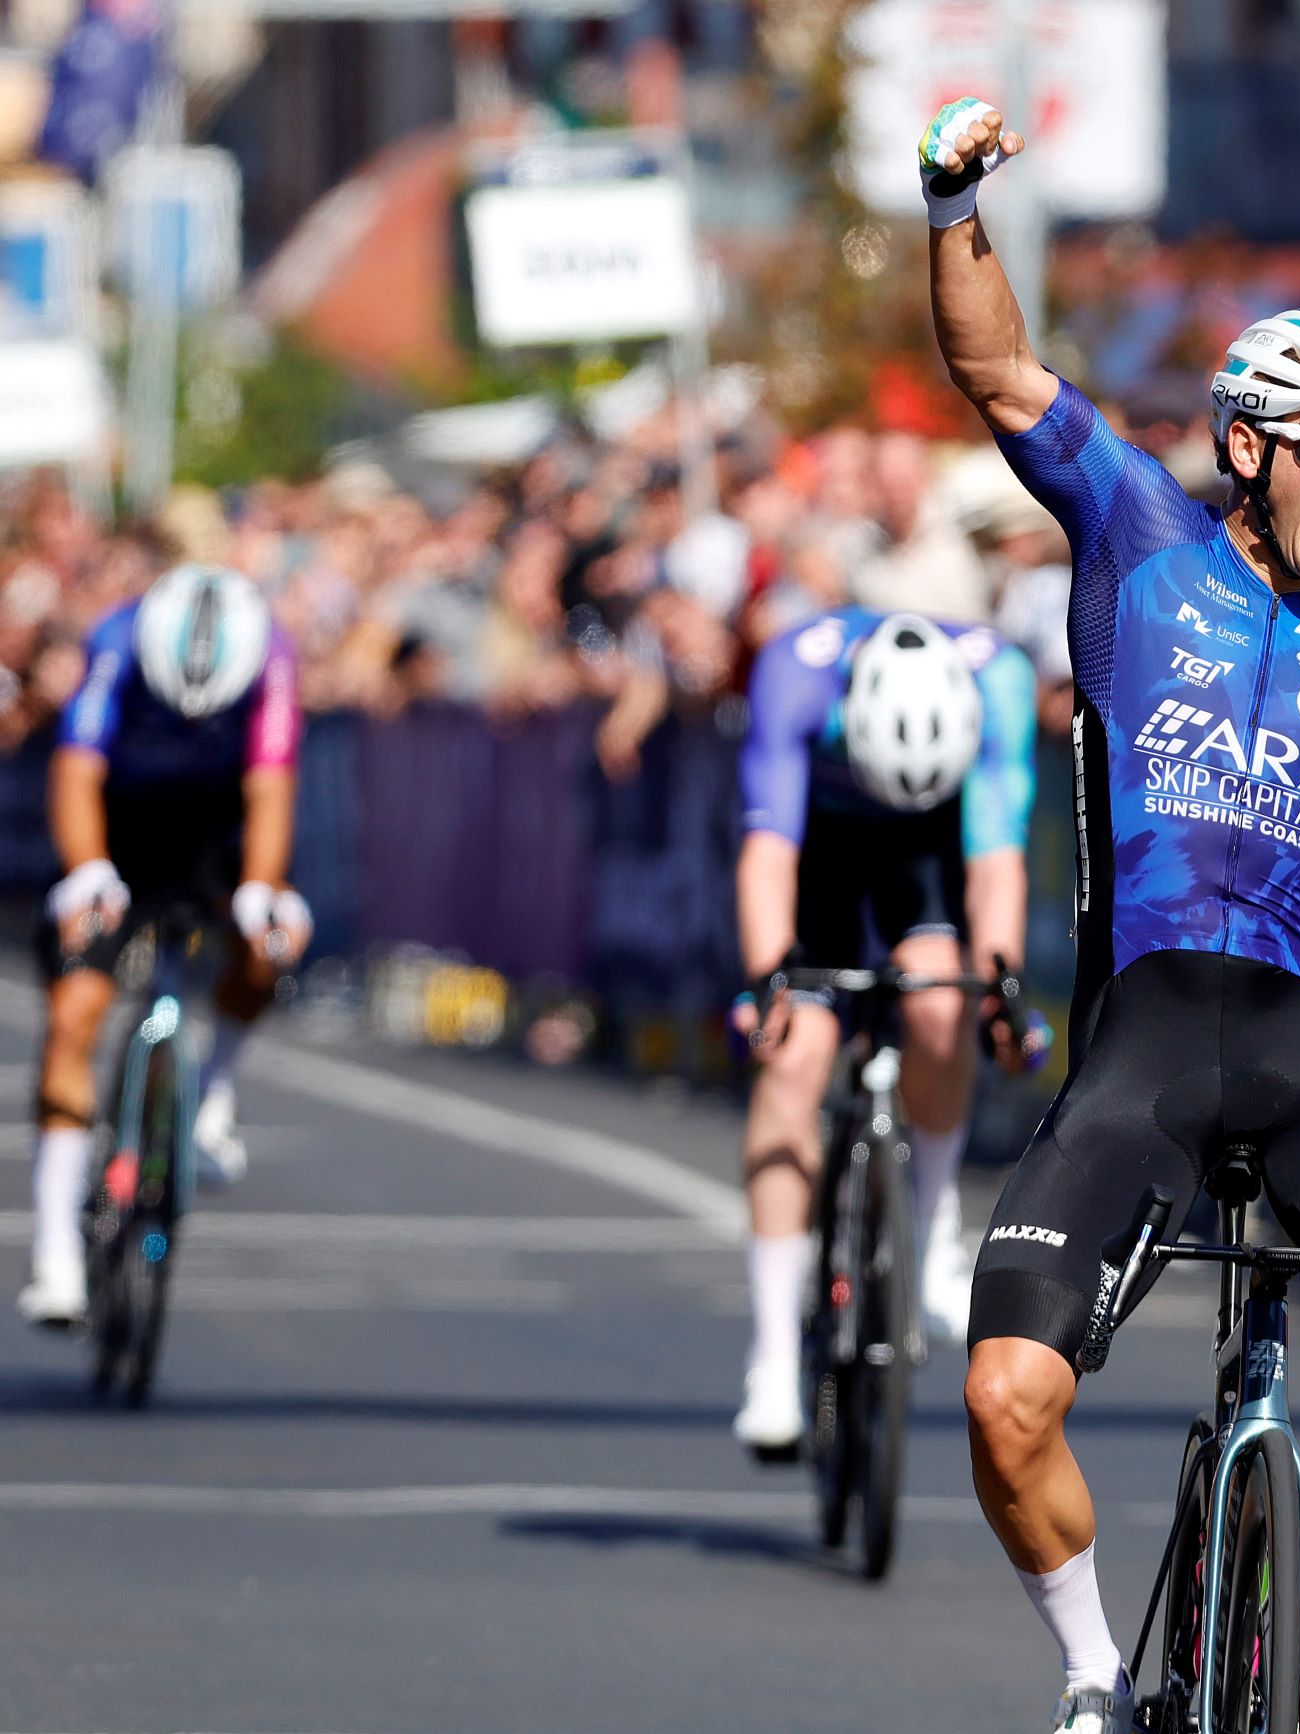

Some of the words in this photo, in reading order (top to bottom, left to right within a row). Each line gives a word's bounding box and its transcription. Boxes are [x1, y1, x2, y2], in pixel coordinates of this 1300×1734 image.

[1193, 581, 1211, 598] Asset
[1211, 593, 1254, 618] Management
[1206, 573, 1249, 608] Wilson
[1217, 626, 1250, 647] UniSC
[1170, 646, 1223, 684] TGI
[1176, 672, 1209, 689] CARGO
[1145, 757, 1211, 796] SKIP
[1072, 708, 1090, 911] LIEBHERR
[1144, 797, 1255, 831] SUNSHINE
[989, 1225, 1068, 1247] MAXXIS
